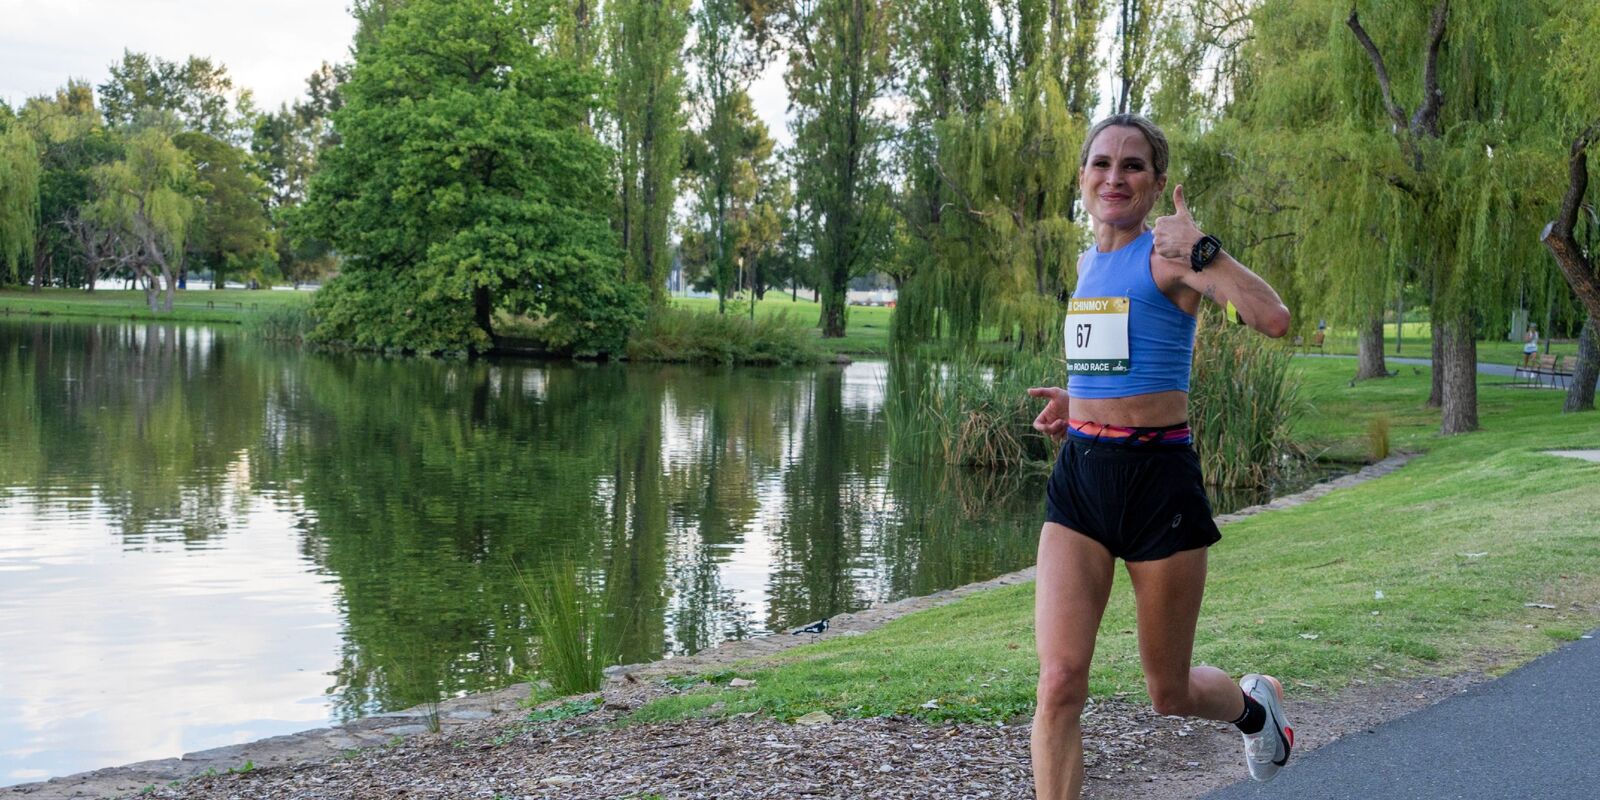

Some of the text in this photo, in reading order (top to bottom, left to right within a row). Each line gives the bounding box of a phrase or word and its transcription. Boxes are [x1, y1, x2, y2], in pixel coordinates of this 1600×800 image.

[1073, 300, 1109, 312] CHINMOY
[1076, 323, 1092, 348] 67
[1073, 363, 1090, 371] ROAD
[1090, 363, 1109, 371] RACE
